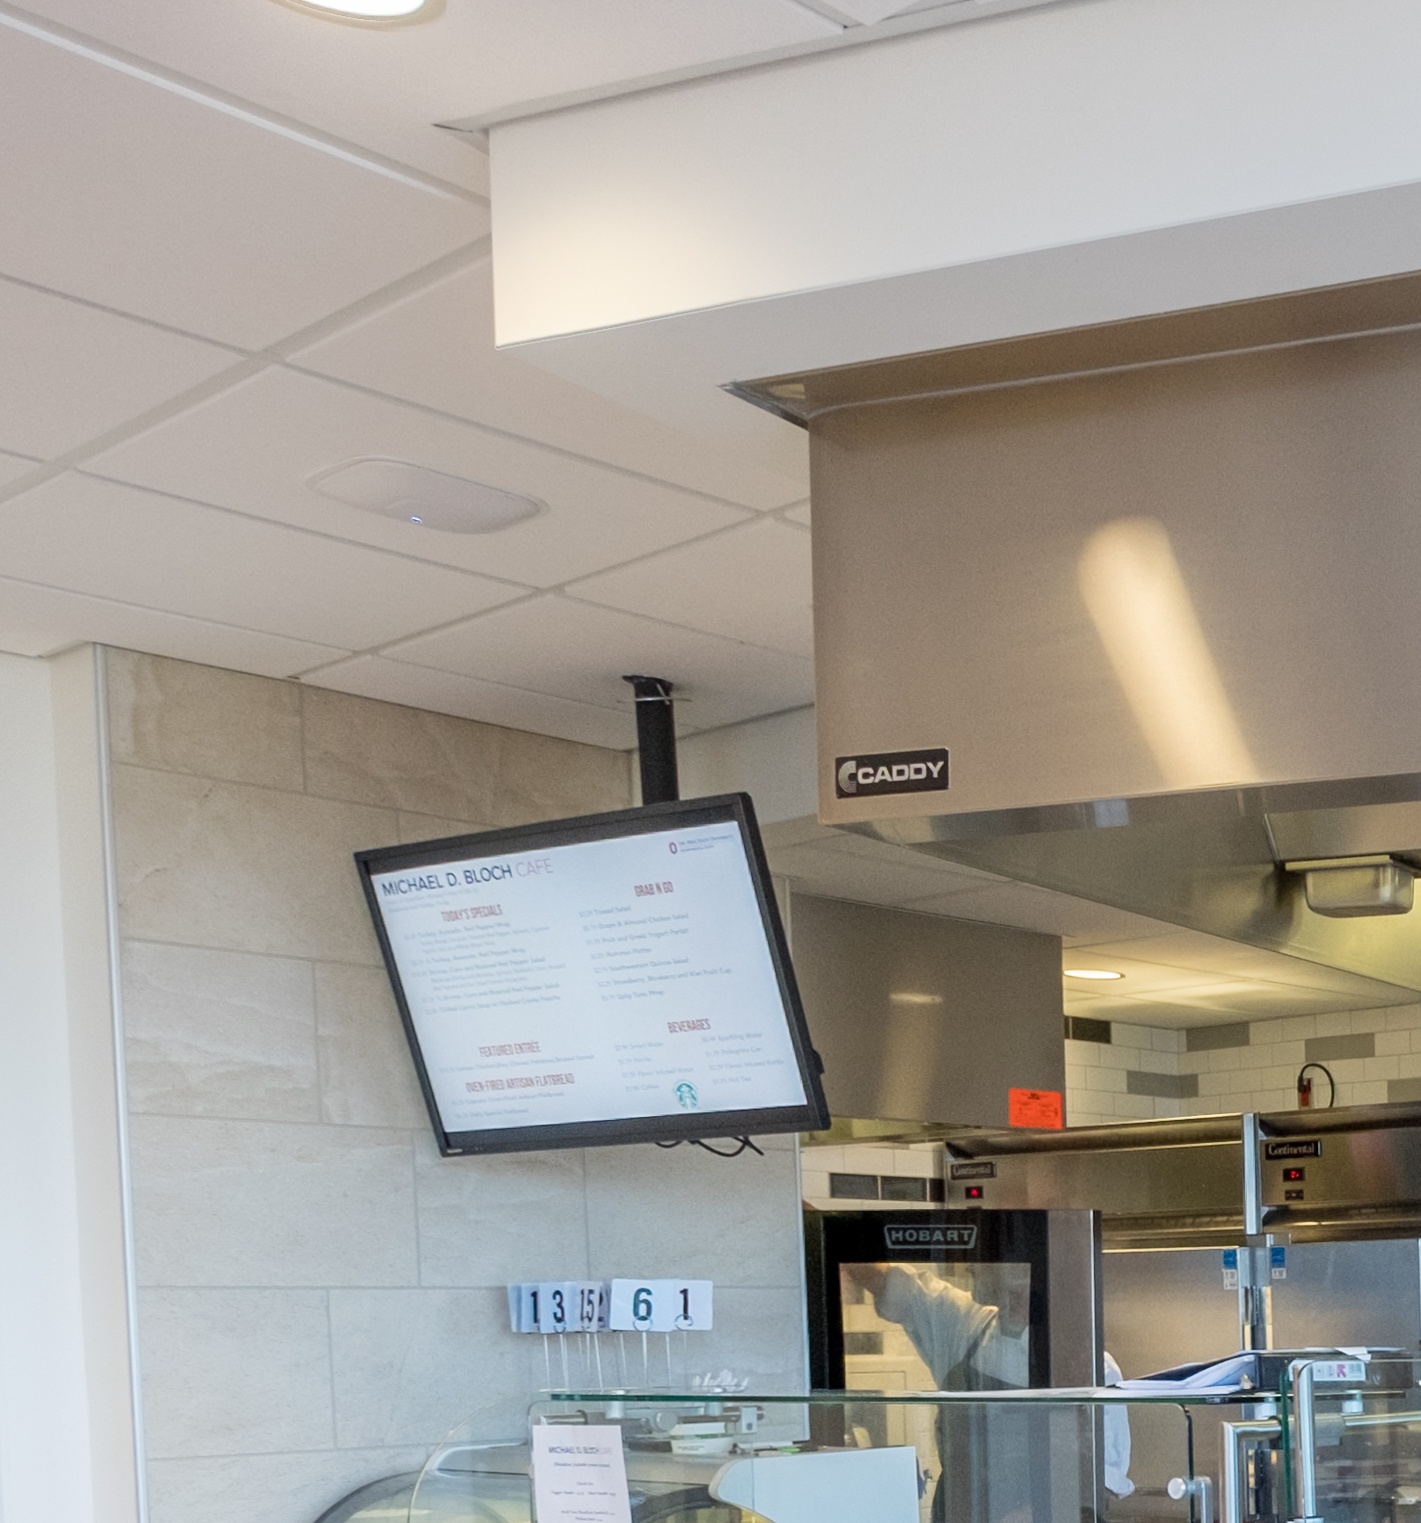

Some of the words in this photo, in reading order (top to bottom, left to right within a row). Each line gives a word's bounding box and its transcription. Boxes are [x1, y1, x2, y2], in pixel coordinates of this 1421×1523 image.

[857, 761, 944, 784] CADDY
[381, 874, 444, 897] MICHAEL
[445, 873, 461, 888] D.
[463, 864, 514, 885] BLOCH
[515, 858, 554, 878] CAFE
[634, 884, 655, 897] GRAB
[656, 882, 663, 894] N
[663, 881, 674, 893] GO
[440, 907, 470, 923] TODAY'S
[471, 904, 503, 920] SPECIALS
[667, 1018, 711, 1033] BEVERAGES
[479, 1043, 514, 1057] FEATURED
[465, 1079, 506, 1093] OVEN-FIRED
[506, 1075, 535, 1090] ARTISAN
[535, 1072, 575, 1088] FLATBREAD
[1269, 1143, 1316, 1157] Continental
[891, 1230, 972, 1241] HOBART
[530, 1291, 538, 1324] 1
[552, 1290, 565, 1324] 3
[633, 1288, 653, 1321] 6
[679, 1288, 689, 1320] 1
